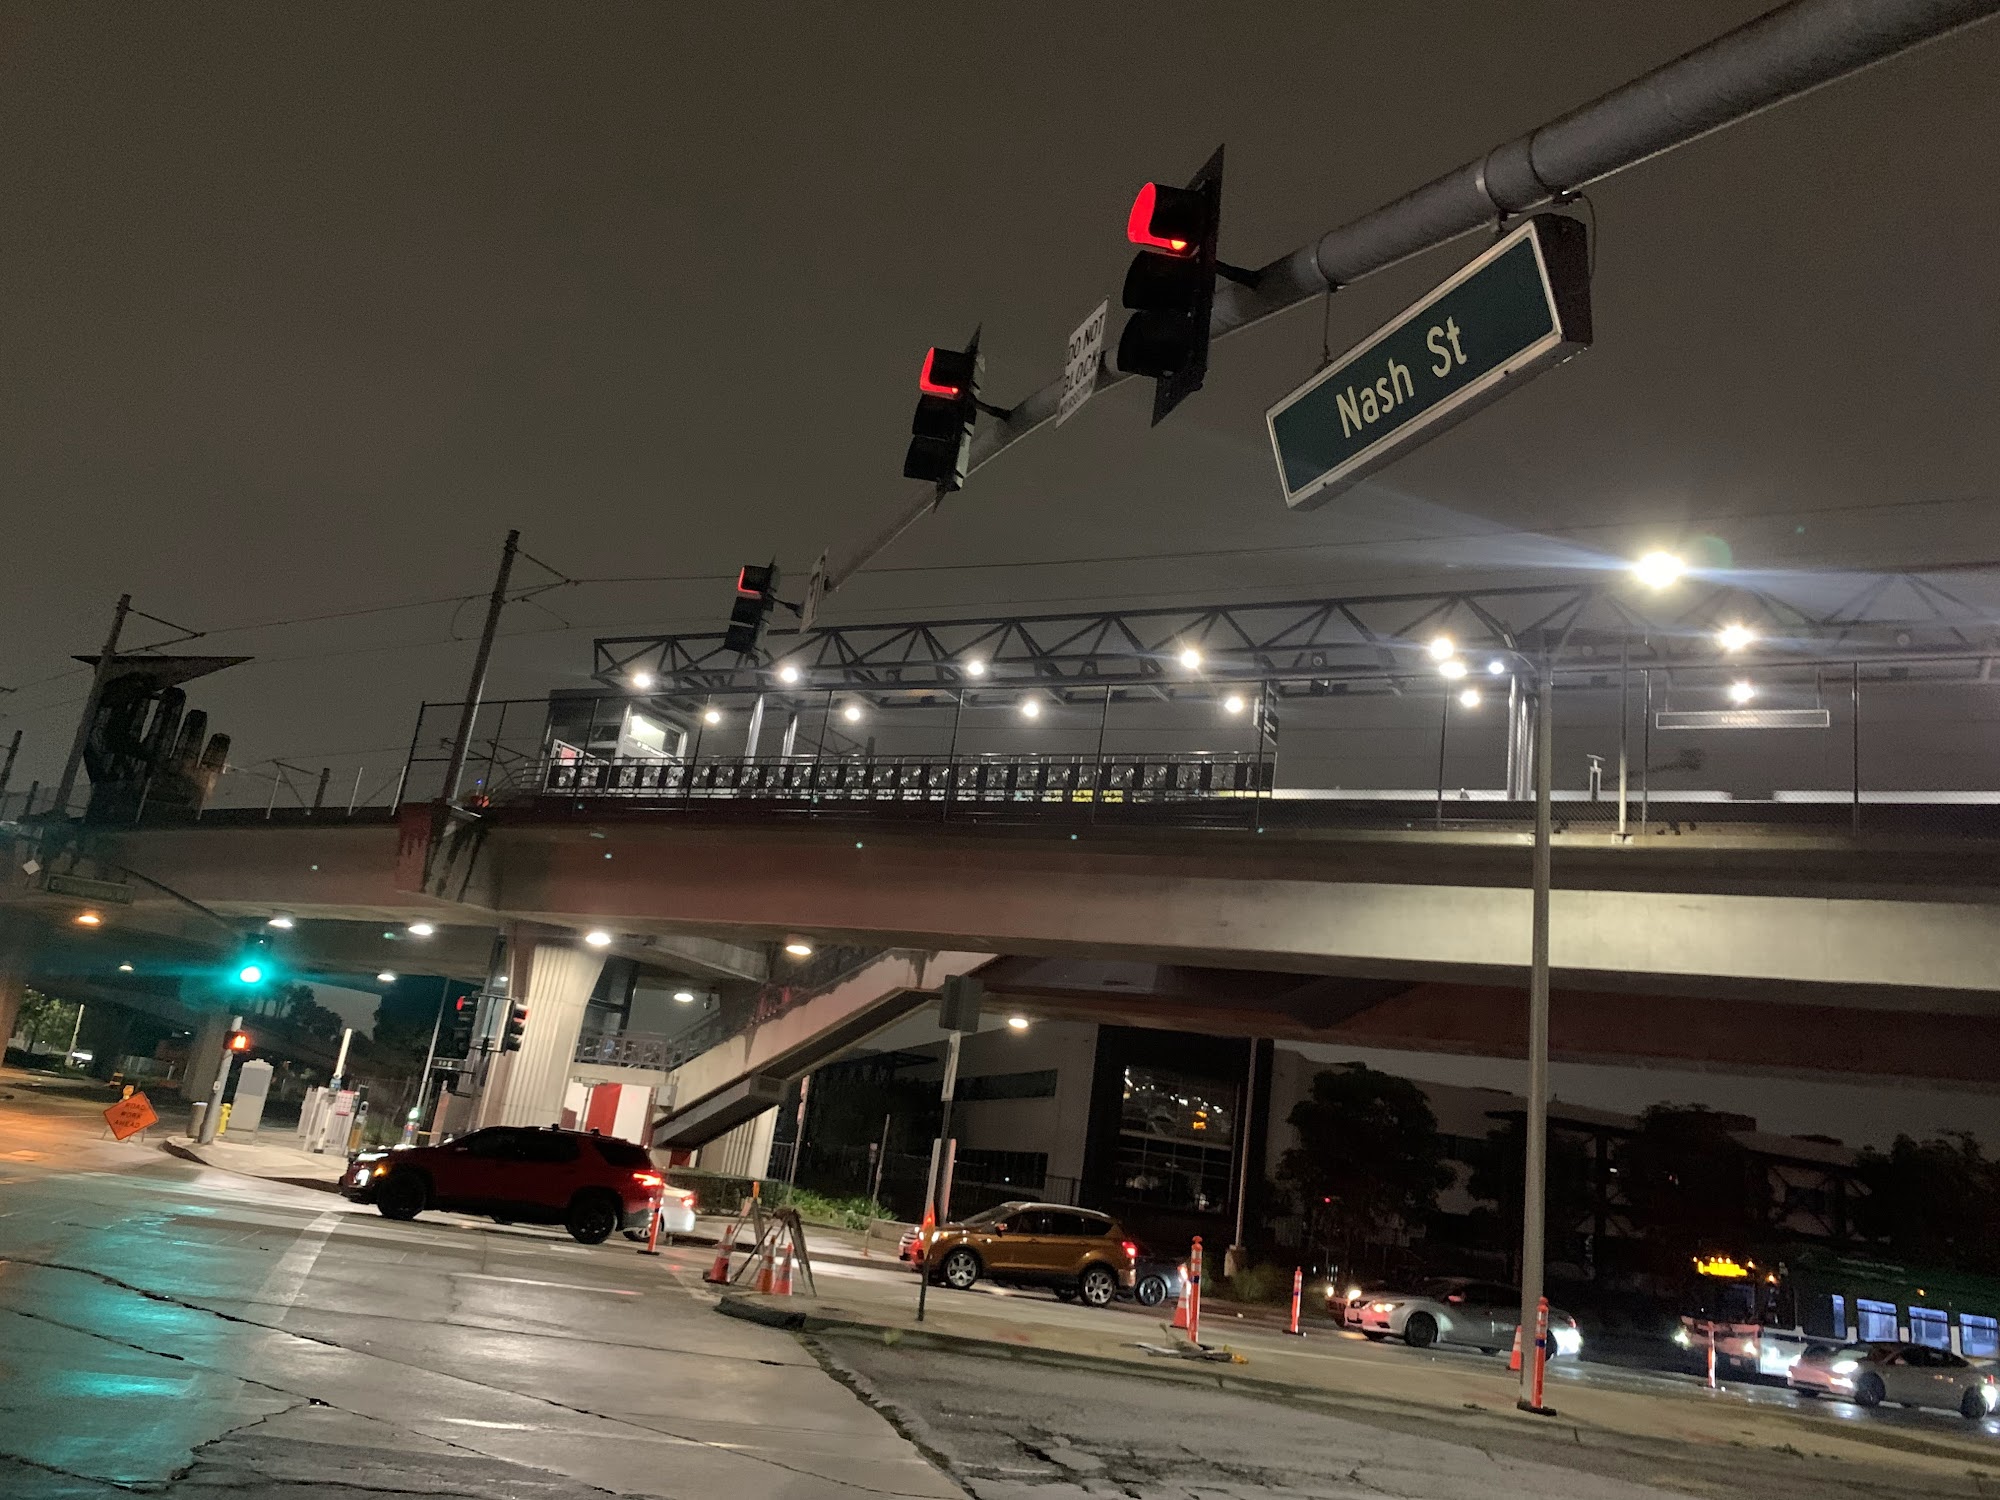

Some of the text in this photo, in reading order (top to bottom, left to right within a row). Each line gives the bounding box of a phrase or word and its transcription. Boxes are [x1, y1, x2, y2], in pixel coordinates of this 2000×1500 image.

[1067, 313, 1104, 366] DO NOT
[1062, 347, 1098, 398] BLOCK
[1336, 317, 1467, 438] Nash St
[120, 1111, 142, 1120] WORK
[125, 1102, 146, 1111] ROAD
[114, 1119, 140, 1129] AHEAD
